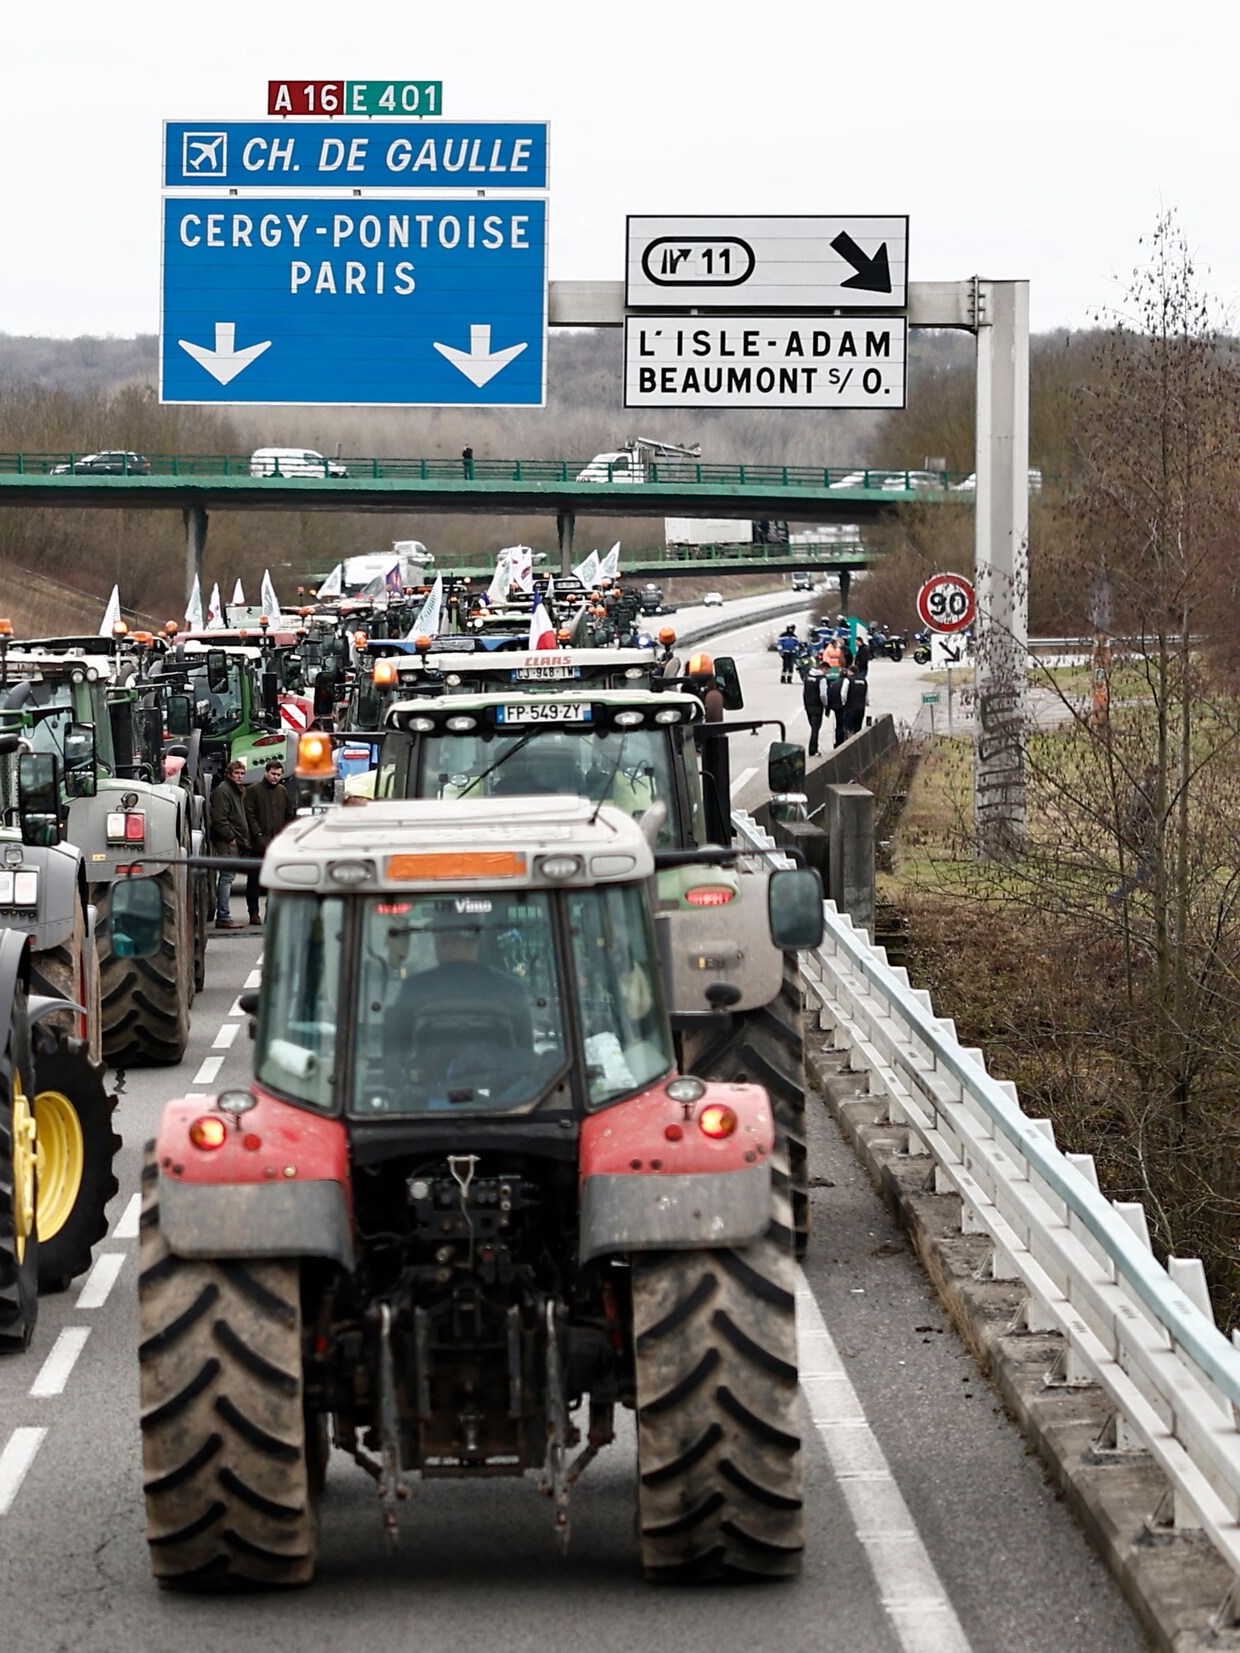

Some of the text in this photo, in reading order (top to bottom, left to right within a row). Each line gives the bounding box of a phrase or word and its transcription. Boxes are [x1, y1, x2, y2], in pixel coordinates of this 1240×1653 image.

[274, 85, 338, 111] A 16
[353, 85, 435, 111] E 401
[242, 137, 533, 172] CH. DE GAULLE
[179, 213, 530, 249] CERGY-PONTOISE
[700, 248, 732, 275] 11
[290, 261, 416, 295] PARIS
[639, 366, 818, 394] BEAUMONT
[929, 592, 966, 616] 90
[524, 656, 571, 667] CLAAS
